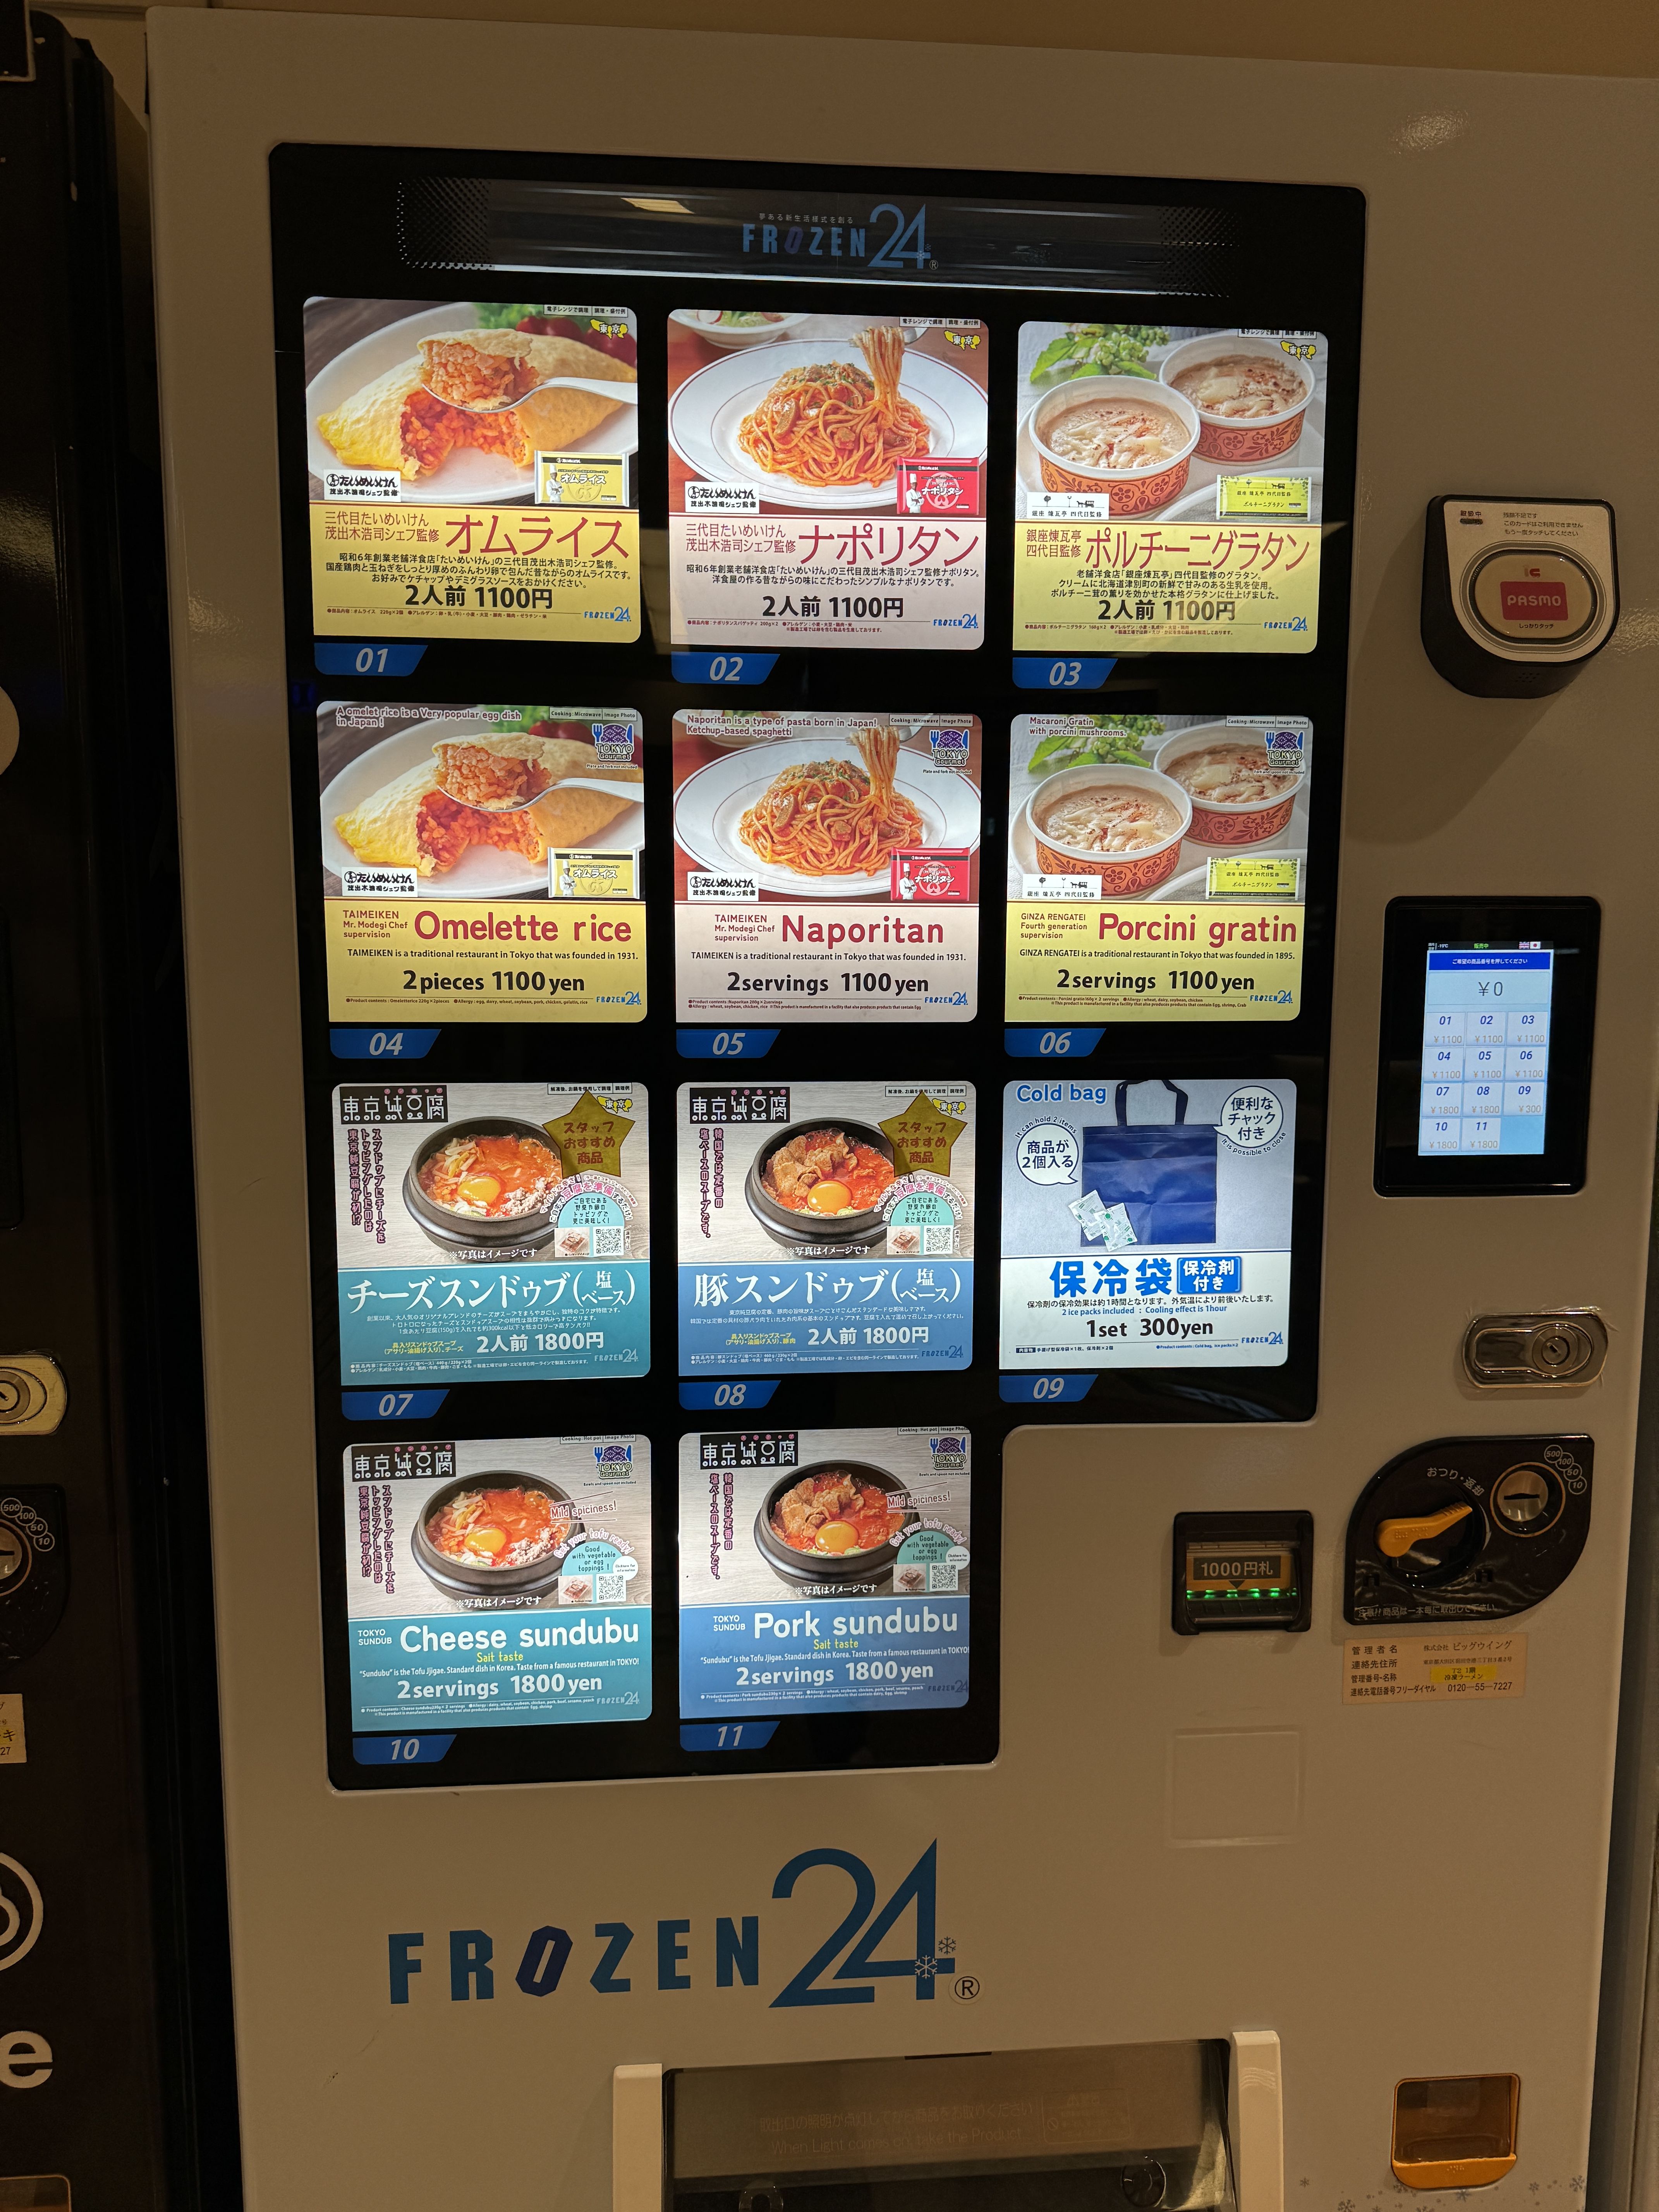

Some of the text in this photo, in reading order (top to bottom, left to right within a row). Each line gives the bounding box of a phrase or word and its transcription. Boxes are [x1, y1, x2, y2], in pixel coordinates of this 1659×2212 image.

[759, 213, 853, 224] 夢ある新生活様式を創る
[743, 223, 866, 257] FROZEN
[325, 511, 429, 527] 三代目たいめいけん
[325, 526, 440, 542] 茂出木浩司シェフ監修
[445, 514, 629, 559] オムライス
[686, 523, 787, 538] 三代目たいめいけん
[1026, 529, 1082, 544] 銀座煉瓦亭
[685, 538, 797, 554] 茂出木浩司シェフ監修
[798, 522, 980, 567] ナポリタン
[1026, 544, 1081, 558] 四代目監修
[1085, 526, 1311, 572] ポルチーニグラタン
[405, 586, 553, 609] 2人前 1100円
[1507, 595, 1561, 606] PASMO
[762, 596, 904, 618] 2人前 1100円
[1098, 600, 1235, 622] 2人前 1100円
[356, 647, 389, 673] 01
[709, 656, 742, 682] 02
[1049, 661, 1082, 687] 03
[687, 726, 793, 737] Ketchup-based spaghetti
[932, 749, 969, 759] TOKYO
[934, 758, 965, 766] Gourmet
[342, 910, 400, 919] TAIMEIKEN
[1020, 912, 1086, 921] GINZA RENGATEI
[342, 921, 409, 931] Mr. Modegi Chef
[414, 910, 632, 943] Omelette rice
[782, 914, 944, 950] Naporitan
[1099, 912, 1297, 949] Porcini gratin
[343, 931, 392, 940] supervision
[1439, 1016, 1451, 1025] 01
[1480, 1015, 1493, 1025] 02
[1522, 1015, 1535, 1025] 03
[369, 1032, 404, 1056] 04
[712, 1032, 745, 1056] 05
[1039, 1031, 1072, 1054] 06
[1437, 1051, 1451, 1061] 04
[1478, 1051, 1492, 1060] 05
[1520, 1051, 1533, 1060] 06
[1017, 1085, 1107, 1104] Cold bag
[1436, 1086, 1450, 1096] 07
[1477, 1086, 1490, 1095] 08
[1518, 1085, 1532, 1095] 09
[1231, 1096, 1274, 1111] 便利な
[1227, 1110, 1277, 1125] チャック
[564, 1121, 615, 1133] スタッフ
[1237, 1126, 1265, 1141] 付き
[1435, 1121, 1448, 1131] 10
[1475, 1121, 1487, 1131] 11
[563, 1137, 616, 1150] おすすめ
[1027, 1139, 1070, 1154] 商品が
[577, 1151, 604, 1164] 商品
[1022, 1154, 1074, 1170] 2個入る
[449, 1247, 538, 1261] ※写真はイメージです
[1182, 1259, 1235, 1276] 保冷剤
[1049, 1258, 1173, 1298] 保冷袋
[1192, 1275, 1224, 1292] 付き
[476, 1331, 605, 1353] 2人前 1800円
[808, 1326, 929, 1345] 2人前 1800円
[714, 1384, 746, 1406] 08
[1032, 1377, 1065, 1400] 09
[378, 1393, 414, 1417] 07
[1427, 1467, 1485, 1497] おつり・返却
[550, 1500, 617, 1519] Mild spiciness!
[1201, 1561, 1273, 1577] 1000円札
[754, 1606, 958, 1640] Pork sundubu
[357, 1628, 386, 1637] TOKYO
[400, 1616, 639, 1653] Cheese sundubu
[358, 1637, 393, 1646] SUNDUB
[1453, 1640, 1512, 1651] ビッグウイング
[498, 1652, 524, 1662] taste
[1352, 1645, 1398, 1655] 管理者名
[1352, 1659, 1397, 1669] 連絡先住所
[1351, 1673, 1397, 1683] 管理番号・名称
[1350, 1685, 1436, 1697] 連絡先電話番号フリーダイヤル
[717, 1725, 744, 1748] 11
[391, 1738, 420, 1761] 10
[386, 1836, 956, 2009] FROZEN 24
